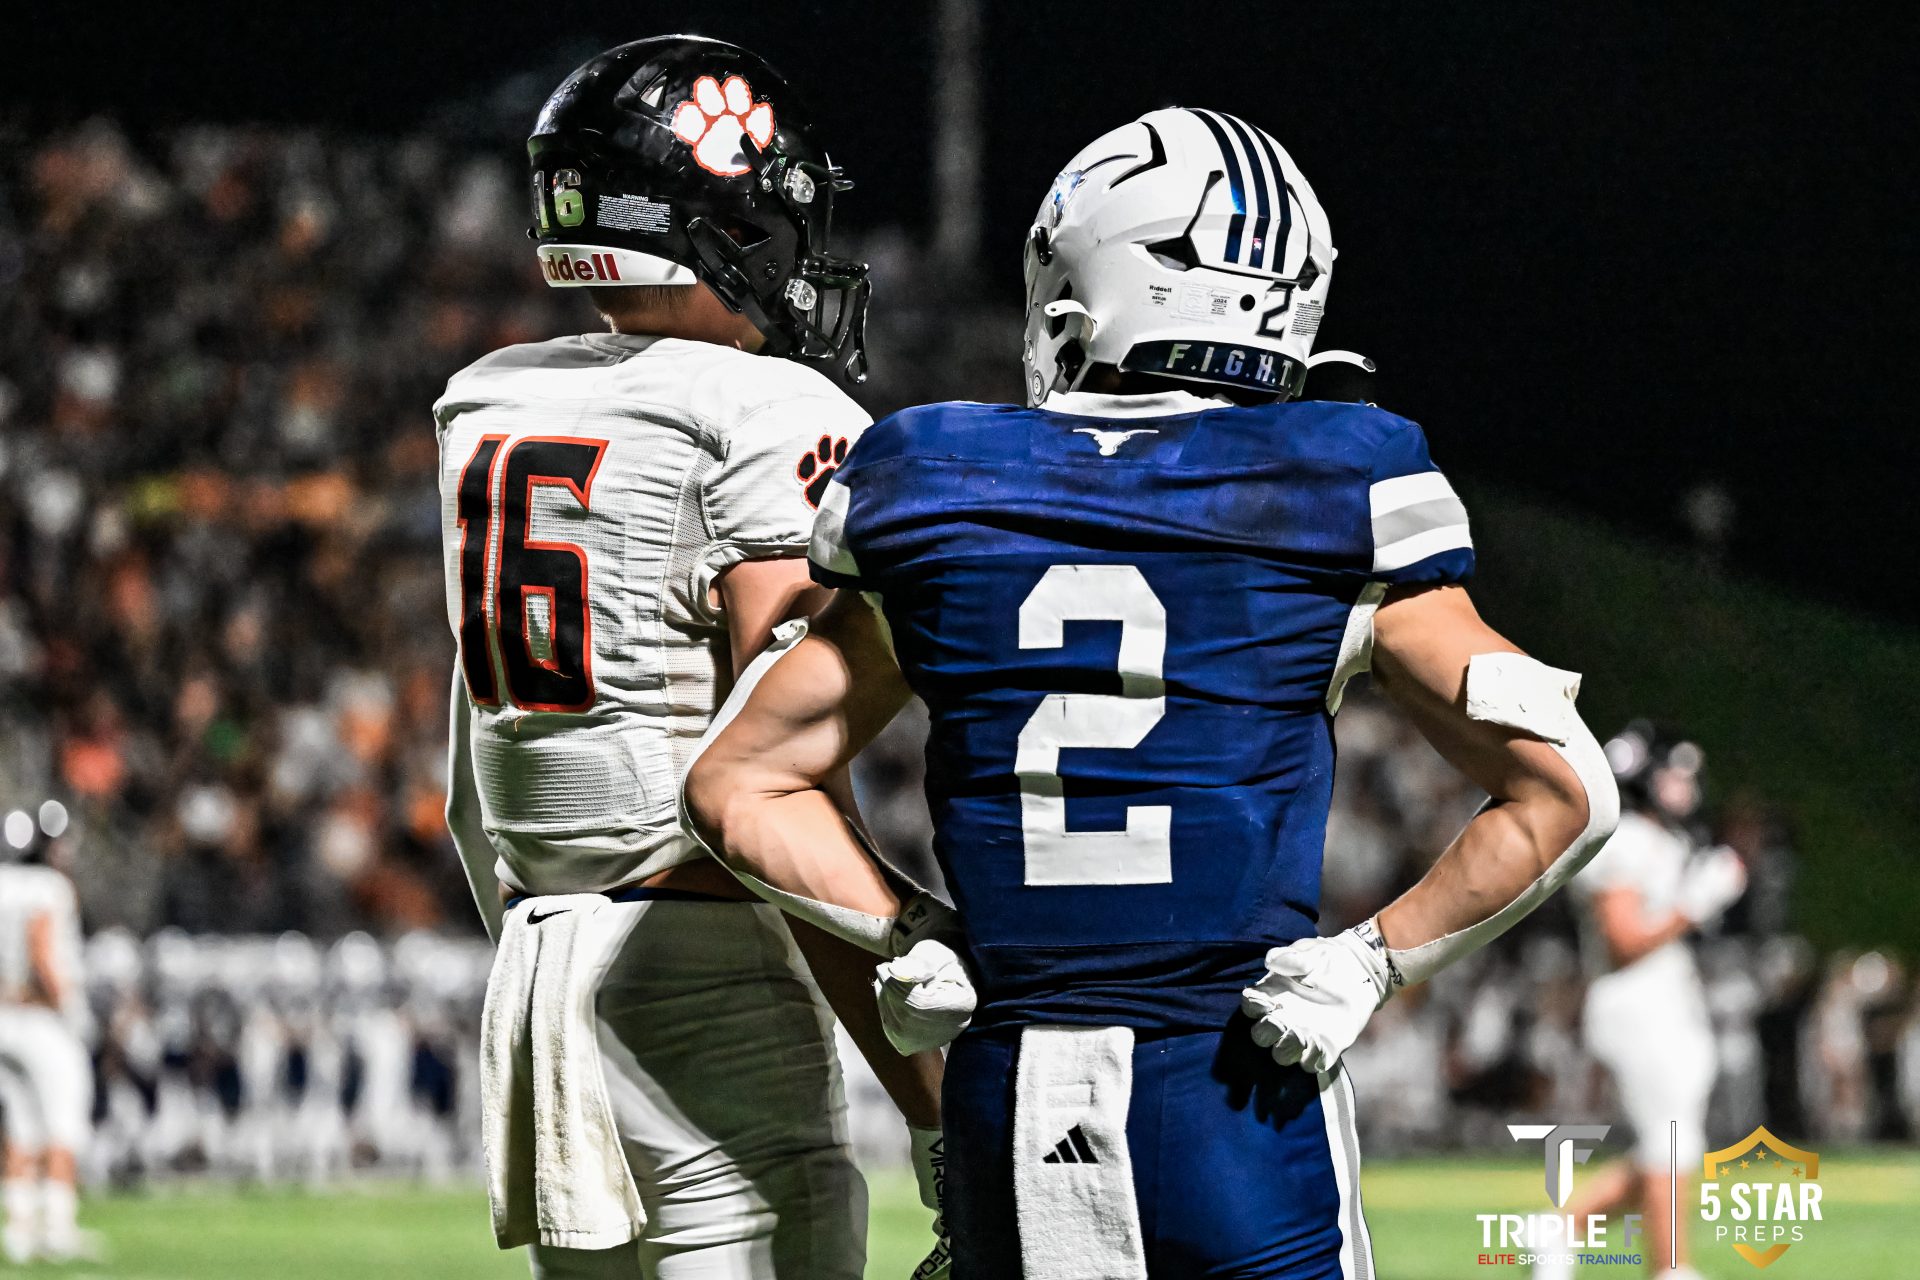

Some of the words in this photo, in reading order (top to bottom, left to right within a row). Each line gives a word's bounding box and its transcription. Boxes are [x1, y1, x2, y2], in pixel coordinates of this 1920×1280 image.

[533, 168, 585, 228] 16
[622, 193, 649, 202] WARNING
[542, 252, 622, 281] ddell
[1149, 284, 1172, 293] Riddell
[1255, 280, 1298, 340] 2
[457, 433, 609, 713] 16
[1014, 564, 1173, 885] 2
